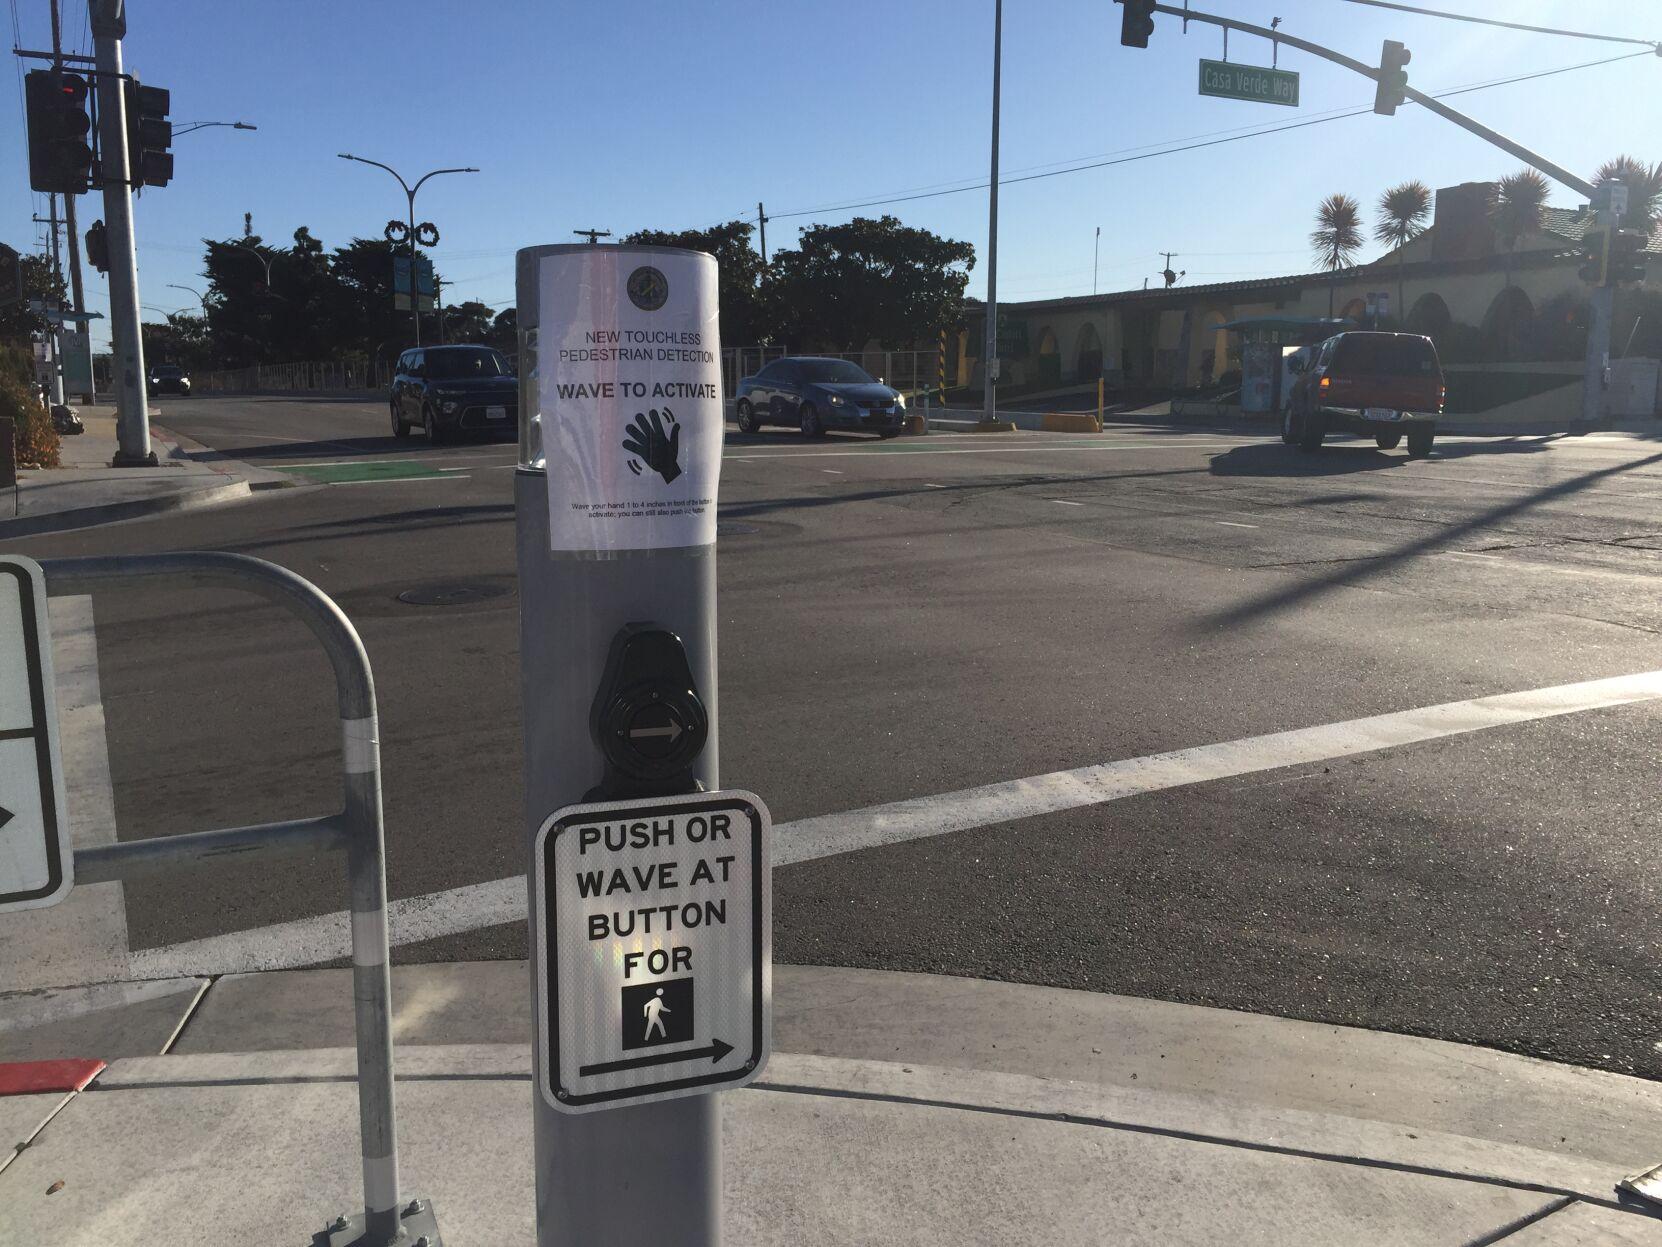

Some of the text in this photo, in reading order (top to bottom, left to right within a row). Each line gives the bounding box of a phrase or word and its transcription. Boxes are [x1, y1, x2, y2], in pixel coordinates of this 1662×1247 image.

[1205, 68, 1295, 101] Casa Verde Way
[585, 331, 700, 346] NEW TOUCHLESS
[559, 349, 714, 363] PEDESTRIAN DETECTION
[556, 382, 716, 399] WAVE TO ACTIVATE
[571, 502, 590, 510] Wave
[591, 502, 607, 511] your
[579, 814, 731, 855] PUSH OR
[576, 856, 735, 898] WAVE AT
[588, 899, 726, 941] BUTTON
[624, 946, 693, 979] FOR
